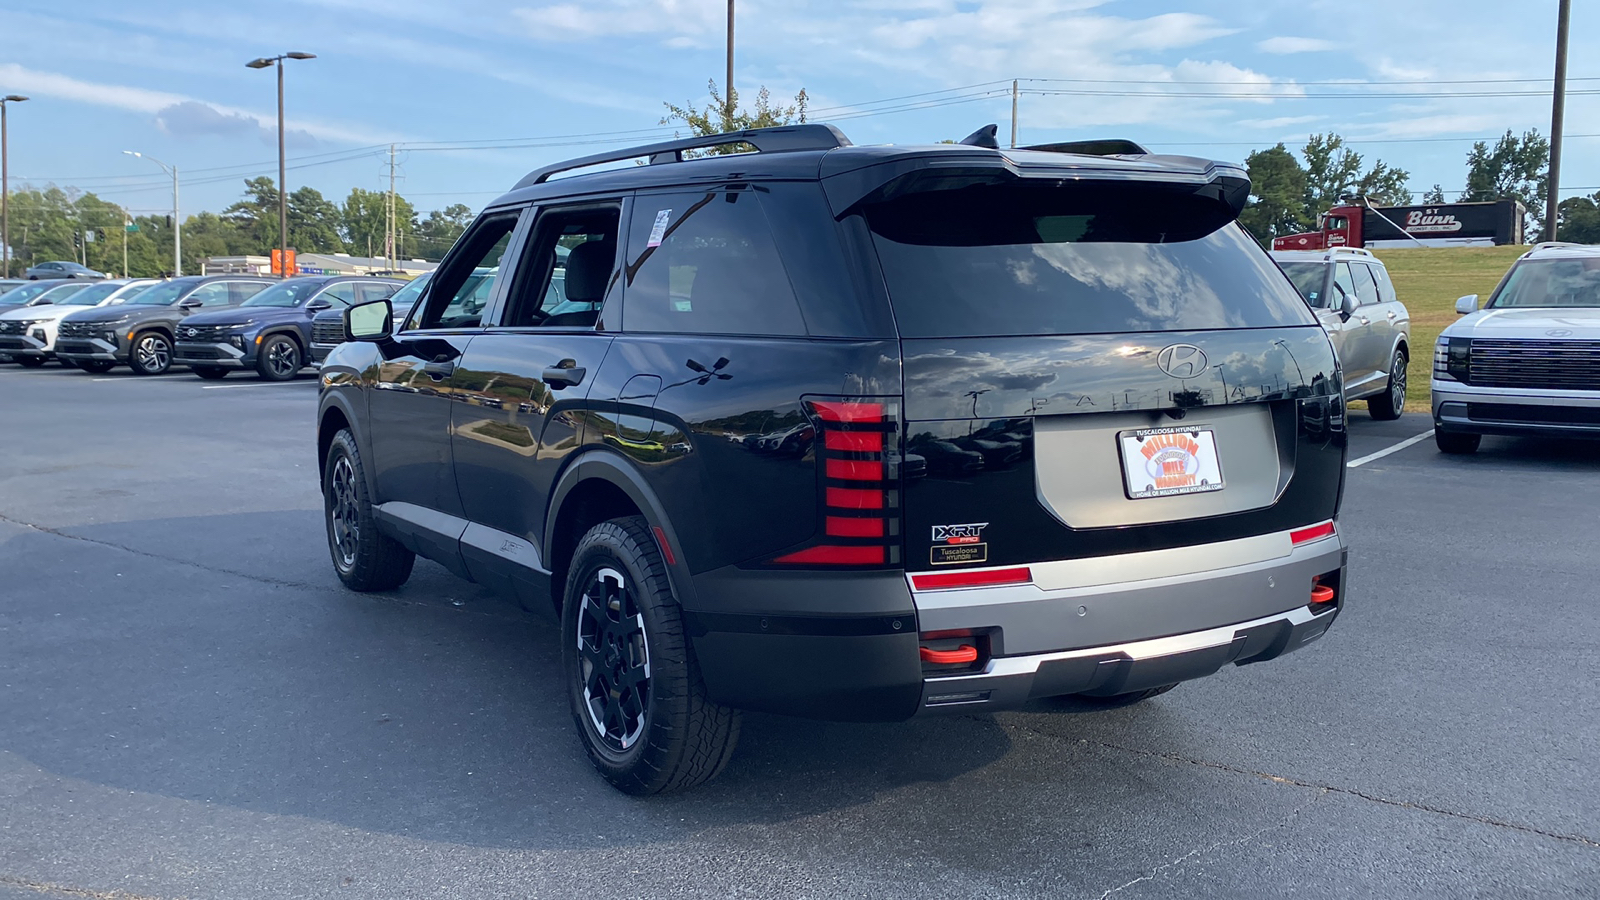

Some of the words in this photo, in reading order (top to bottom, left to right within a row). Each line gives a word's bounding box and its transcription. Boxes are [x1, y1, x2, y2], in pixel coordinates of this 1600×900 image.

[1407, 210, 1456, 226] Bunn
[1136, 427, 1175, 436] TUSCALOOSA
[1175, 425, 1202, 433] HYUNDAI
[1140, 433, 1199, 460] MILLION
[1162, 460, 1186, 475] MILE
[1154, 474, 1196, 488] WARRANTY
[931, 522, 989, 541] XRT
[940, 547, 978, 555] Tuscaloosa
